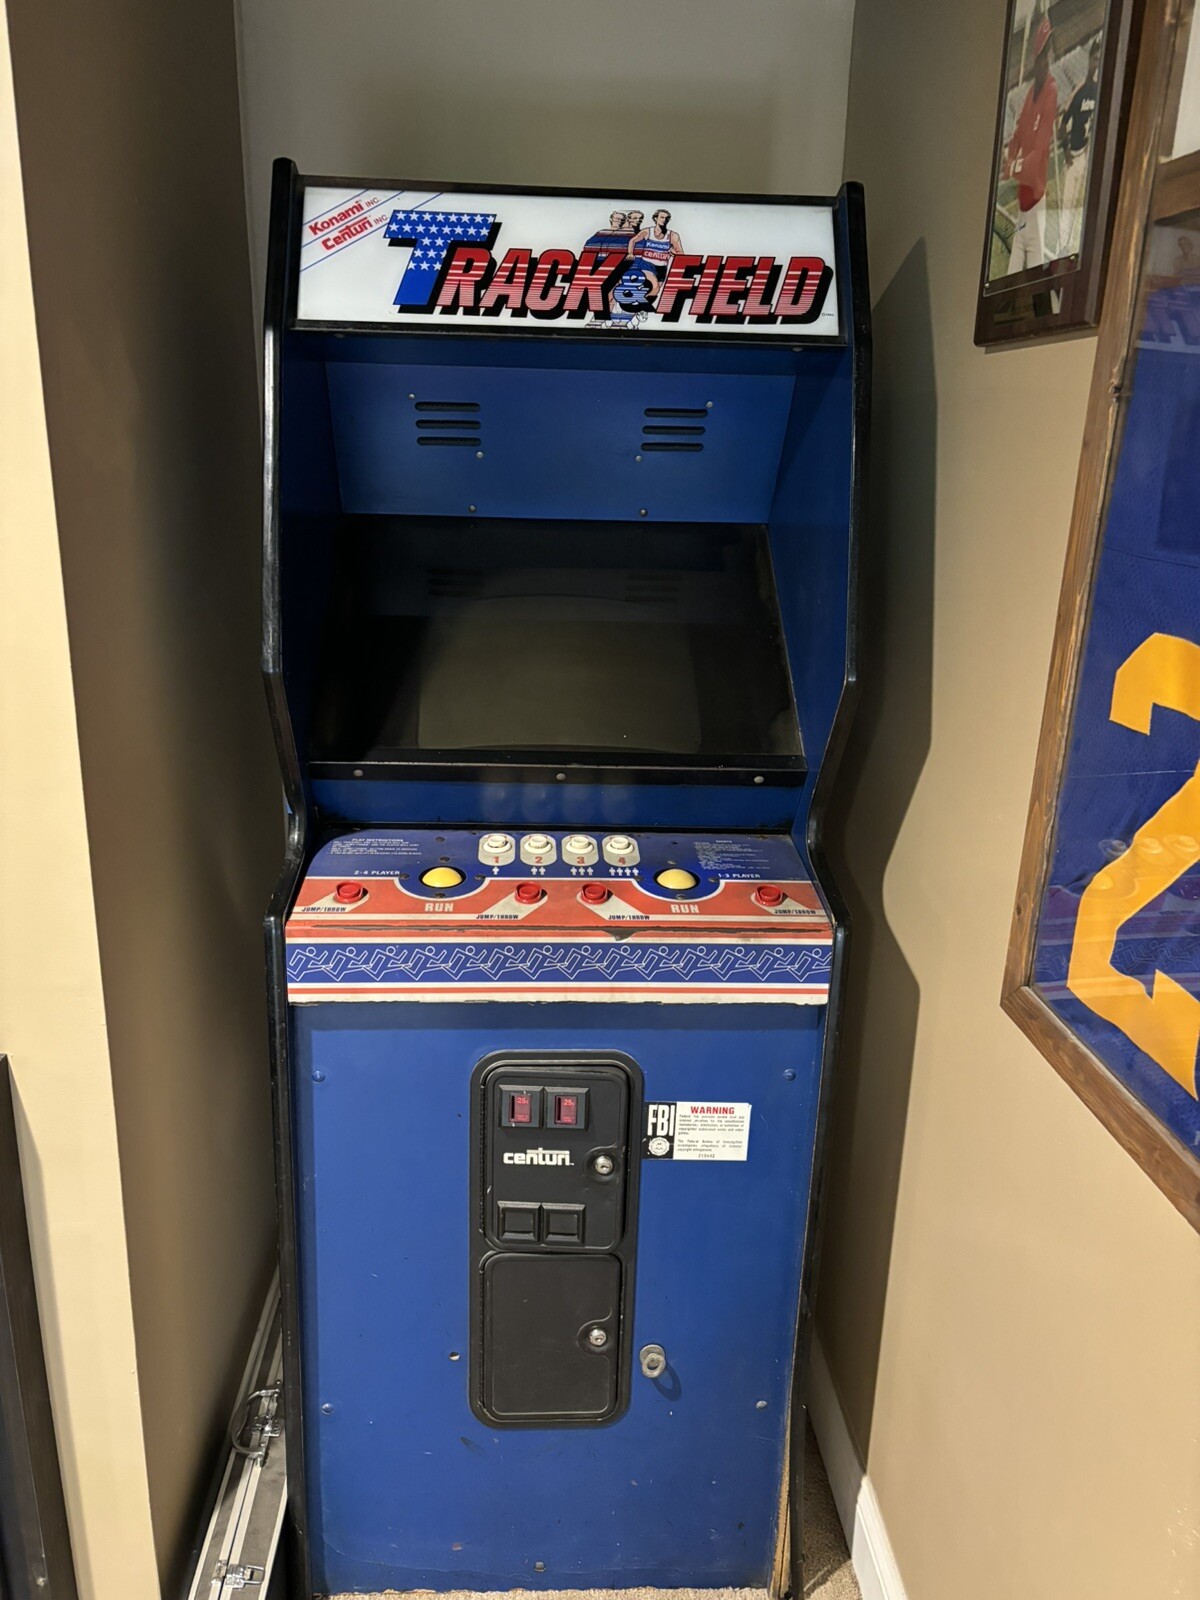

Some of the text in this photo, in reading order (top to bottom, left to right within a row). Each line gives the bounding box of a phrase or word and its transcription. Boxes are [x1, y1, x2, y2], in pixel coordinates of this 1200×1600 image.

[309, 201, 364, 236] Konami
[383, 209, 633, 321] TRACK
[656, 254, 833, 324] FIELD
[535, 856, 543, 864] 2
[577, 856, 585, 864] 3
[618, 857, 626, 865] 4
[424, 902, 454, 912] RUN
[670, 903, 699, 914] RUN
[690, 1106, 735, 1115] WARNING
[647, 1104, 676, 1137] FBI
